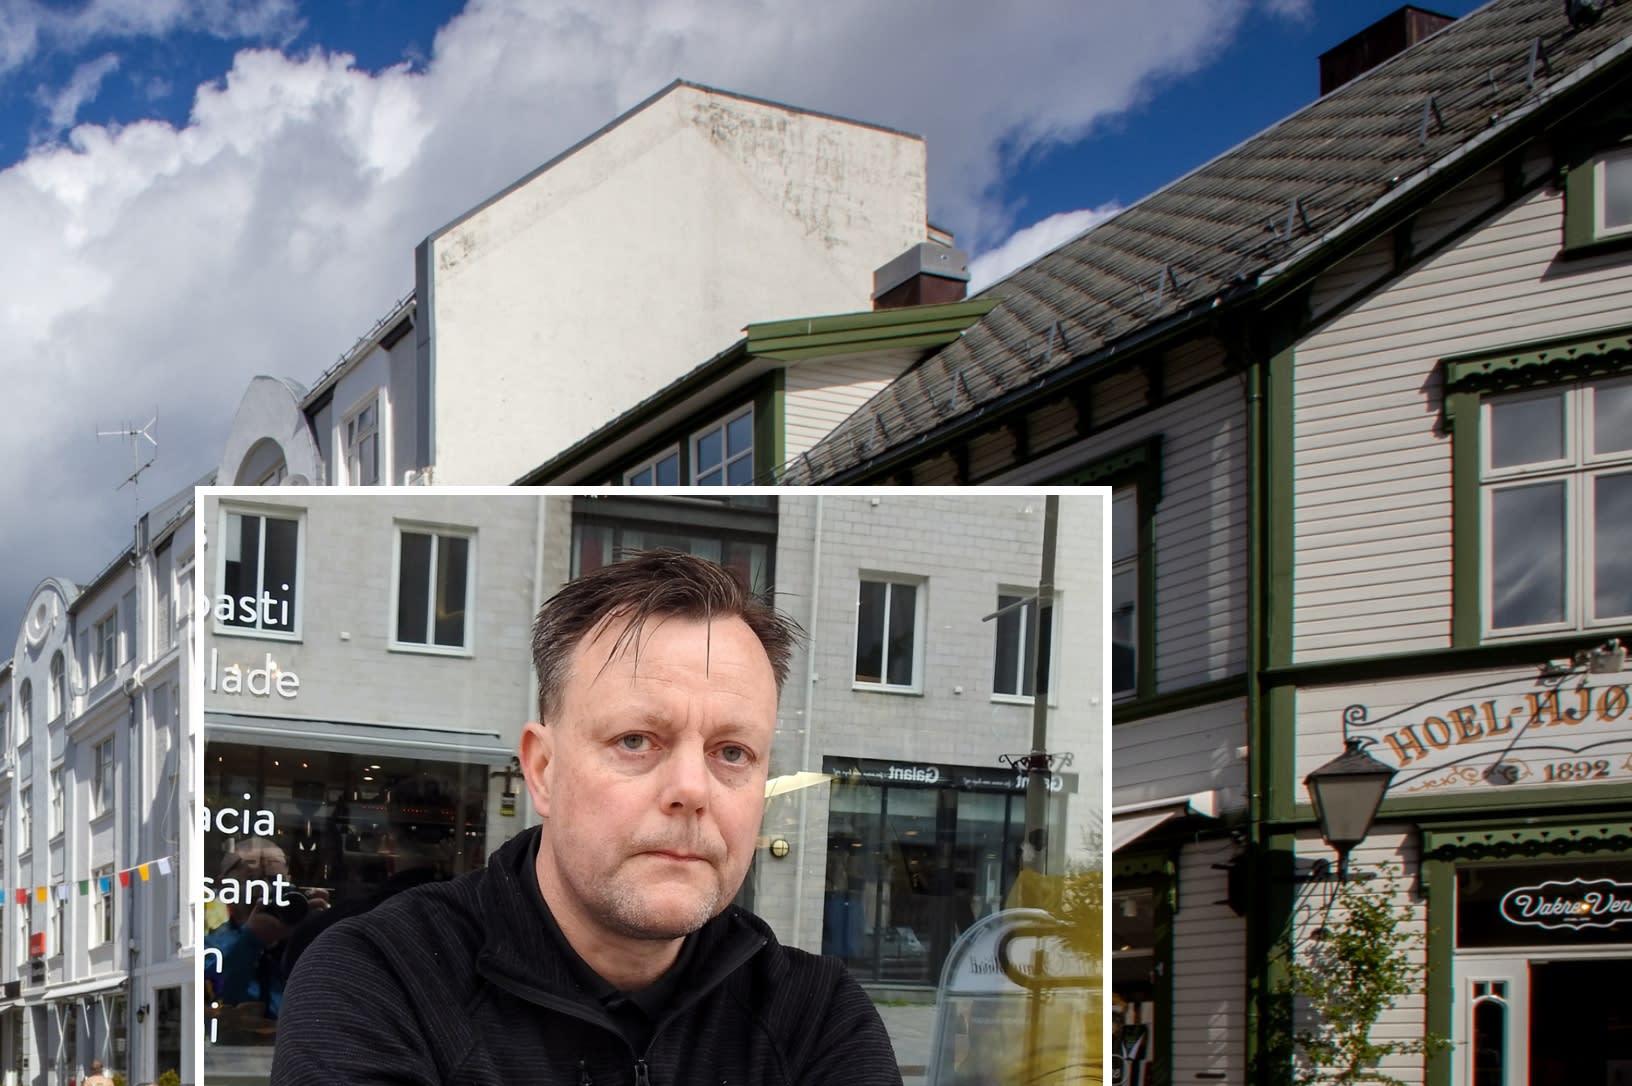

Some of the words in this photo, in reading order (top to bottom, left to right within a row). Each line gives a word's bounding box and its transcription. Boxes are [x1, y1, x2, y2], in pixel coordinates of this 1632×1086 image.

[204, 583, 289, 626] asti
[204, 648, 300, 698] lade
[1384, 684, 1632, 768] HOEL-HJØ
[1544, 760, 1610, 782] 1892
[1515, 895, 1581, 917] Vakre
